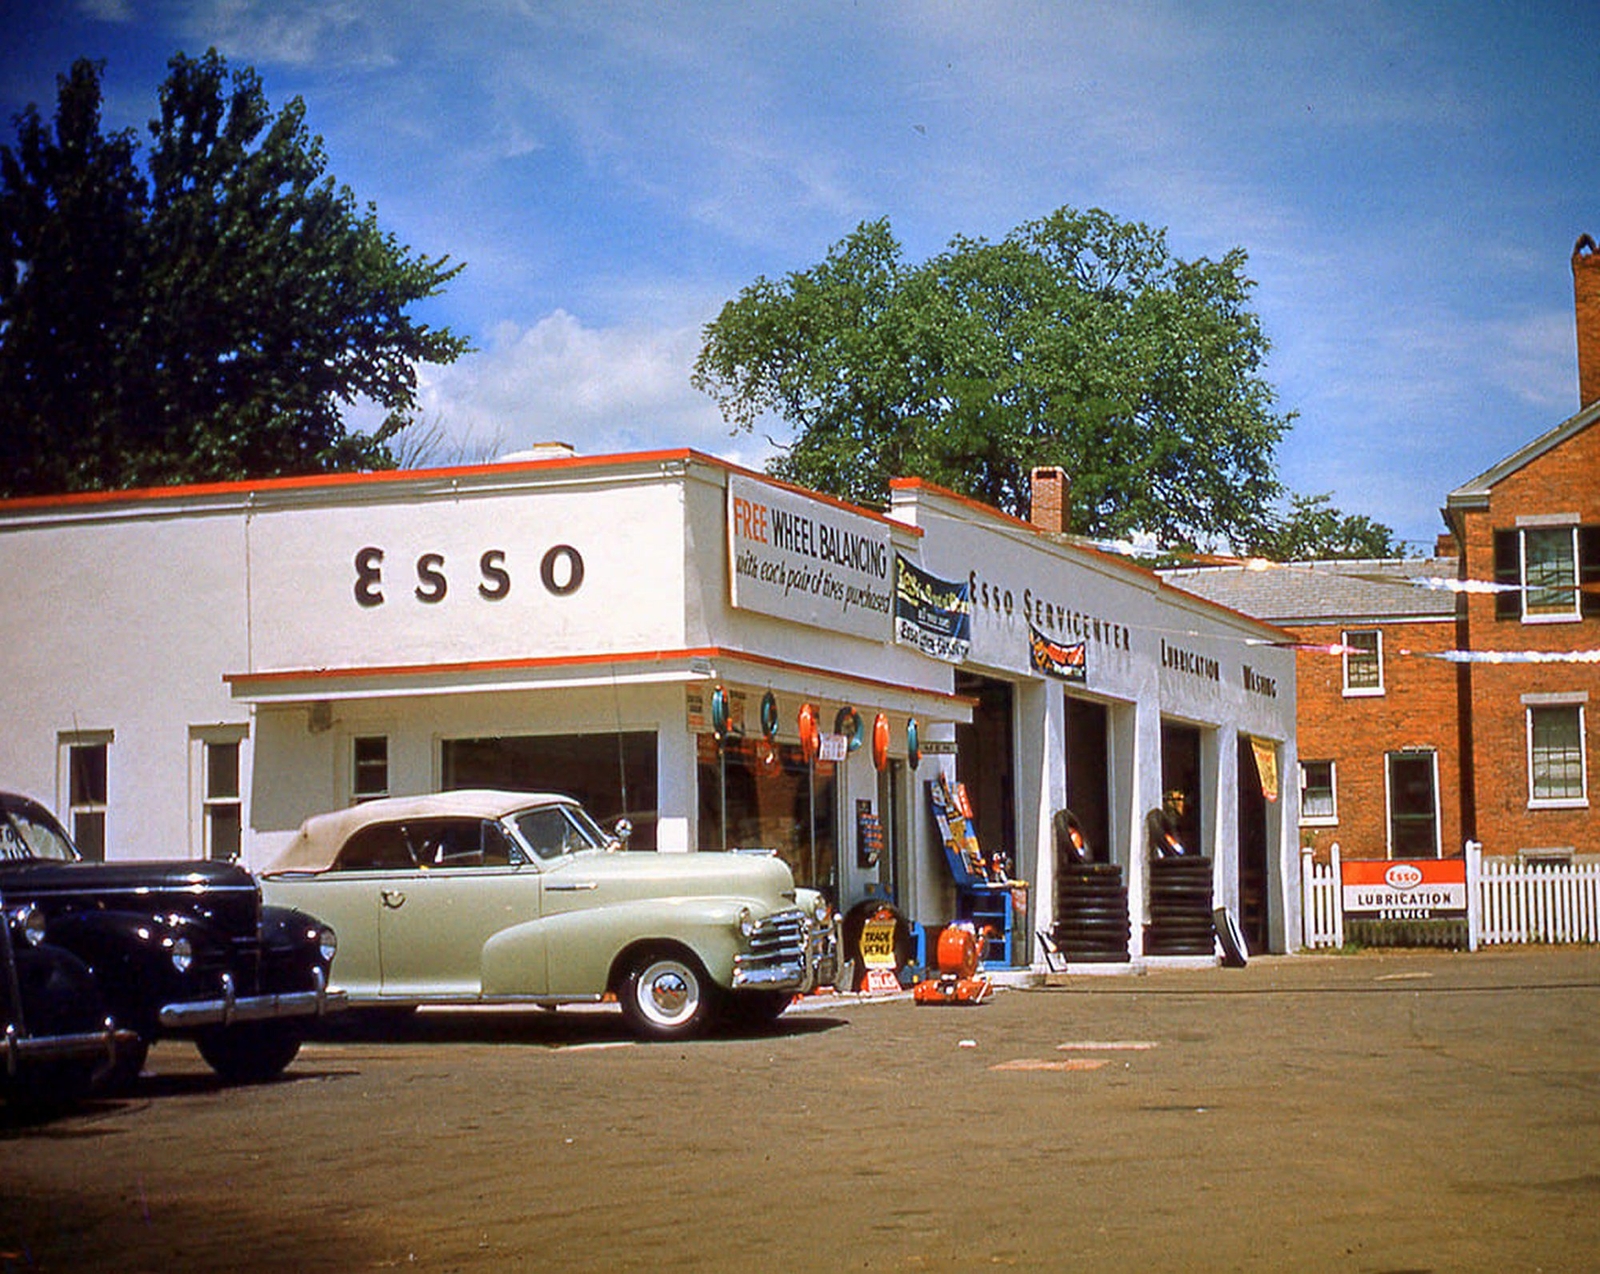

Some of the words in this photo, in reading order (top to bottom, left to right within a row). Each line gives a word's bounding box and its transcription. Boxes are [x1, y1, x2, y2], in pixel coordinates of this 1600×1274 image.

[734, 497, 768, 544] FREE
[771, 509, 818, 558] WHEEL
[819, 524, 887, 580] BALANCING
[353, 544, 585, 609] ESSO
[736, 550, 759, 579] with
[760, 560, 786, 584] each
[785, 565, 811, 597] pair
[822, 571, 844, 601] tires
[843, 583, 892, 614] purchased
[1358, 893, 1451, 905] LUBRICATION
[1379, 910, 1430, 919] SERVICE
